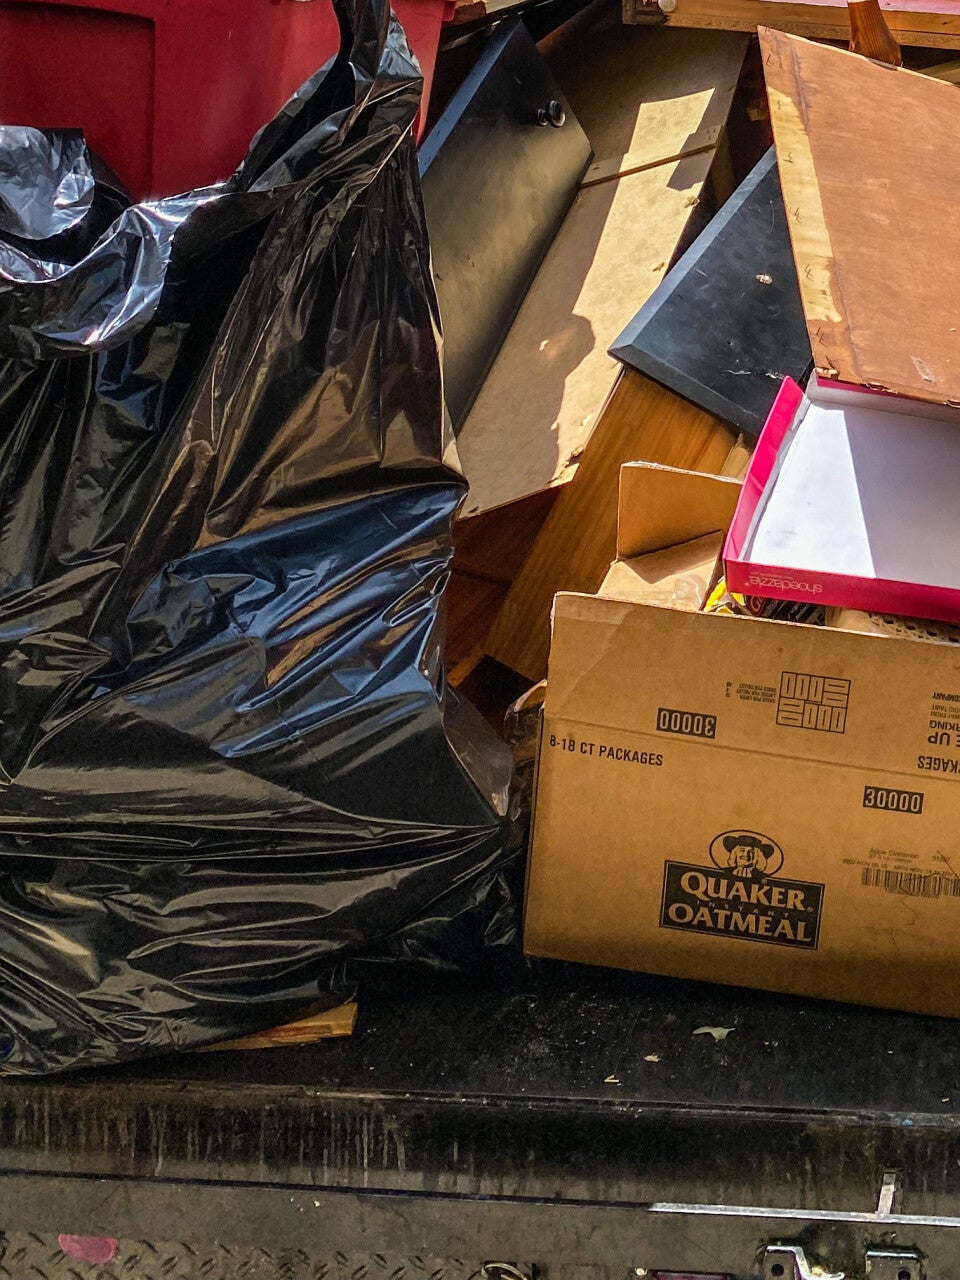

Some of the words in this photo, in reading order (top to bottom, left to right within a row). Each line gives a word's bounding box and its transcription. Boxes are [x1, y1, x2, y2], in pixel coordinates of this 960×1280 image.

[750, 575, 823, 594] shoedazzle
[659, 710, 715, 736] 30000
[550, 734, 576, 752] 8-18
[580, 741, 595, 755] CT
[599, 745, 664, 766] PACKAGES
[927, 731, 950, 746] UP
[865, 788, 920, 812] 30000
[680, 871, 806, 911] QUAKER
[668, 902, 812, 942] OATMEAL
